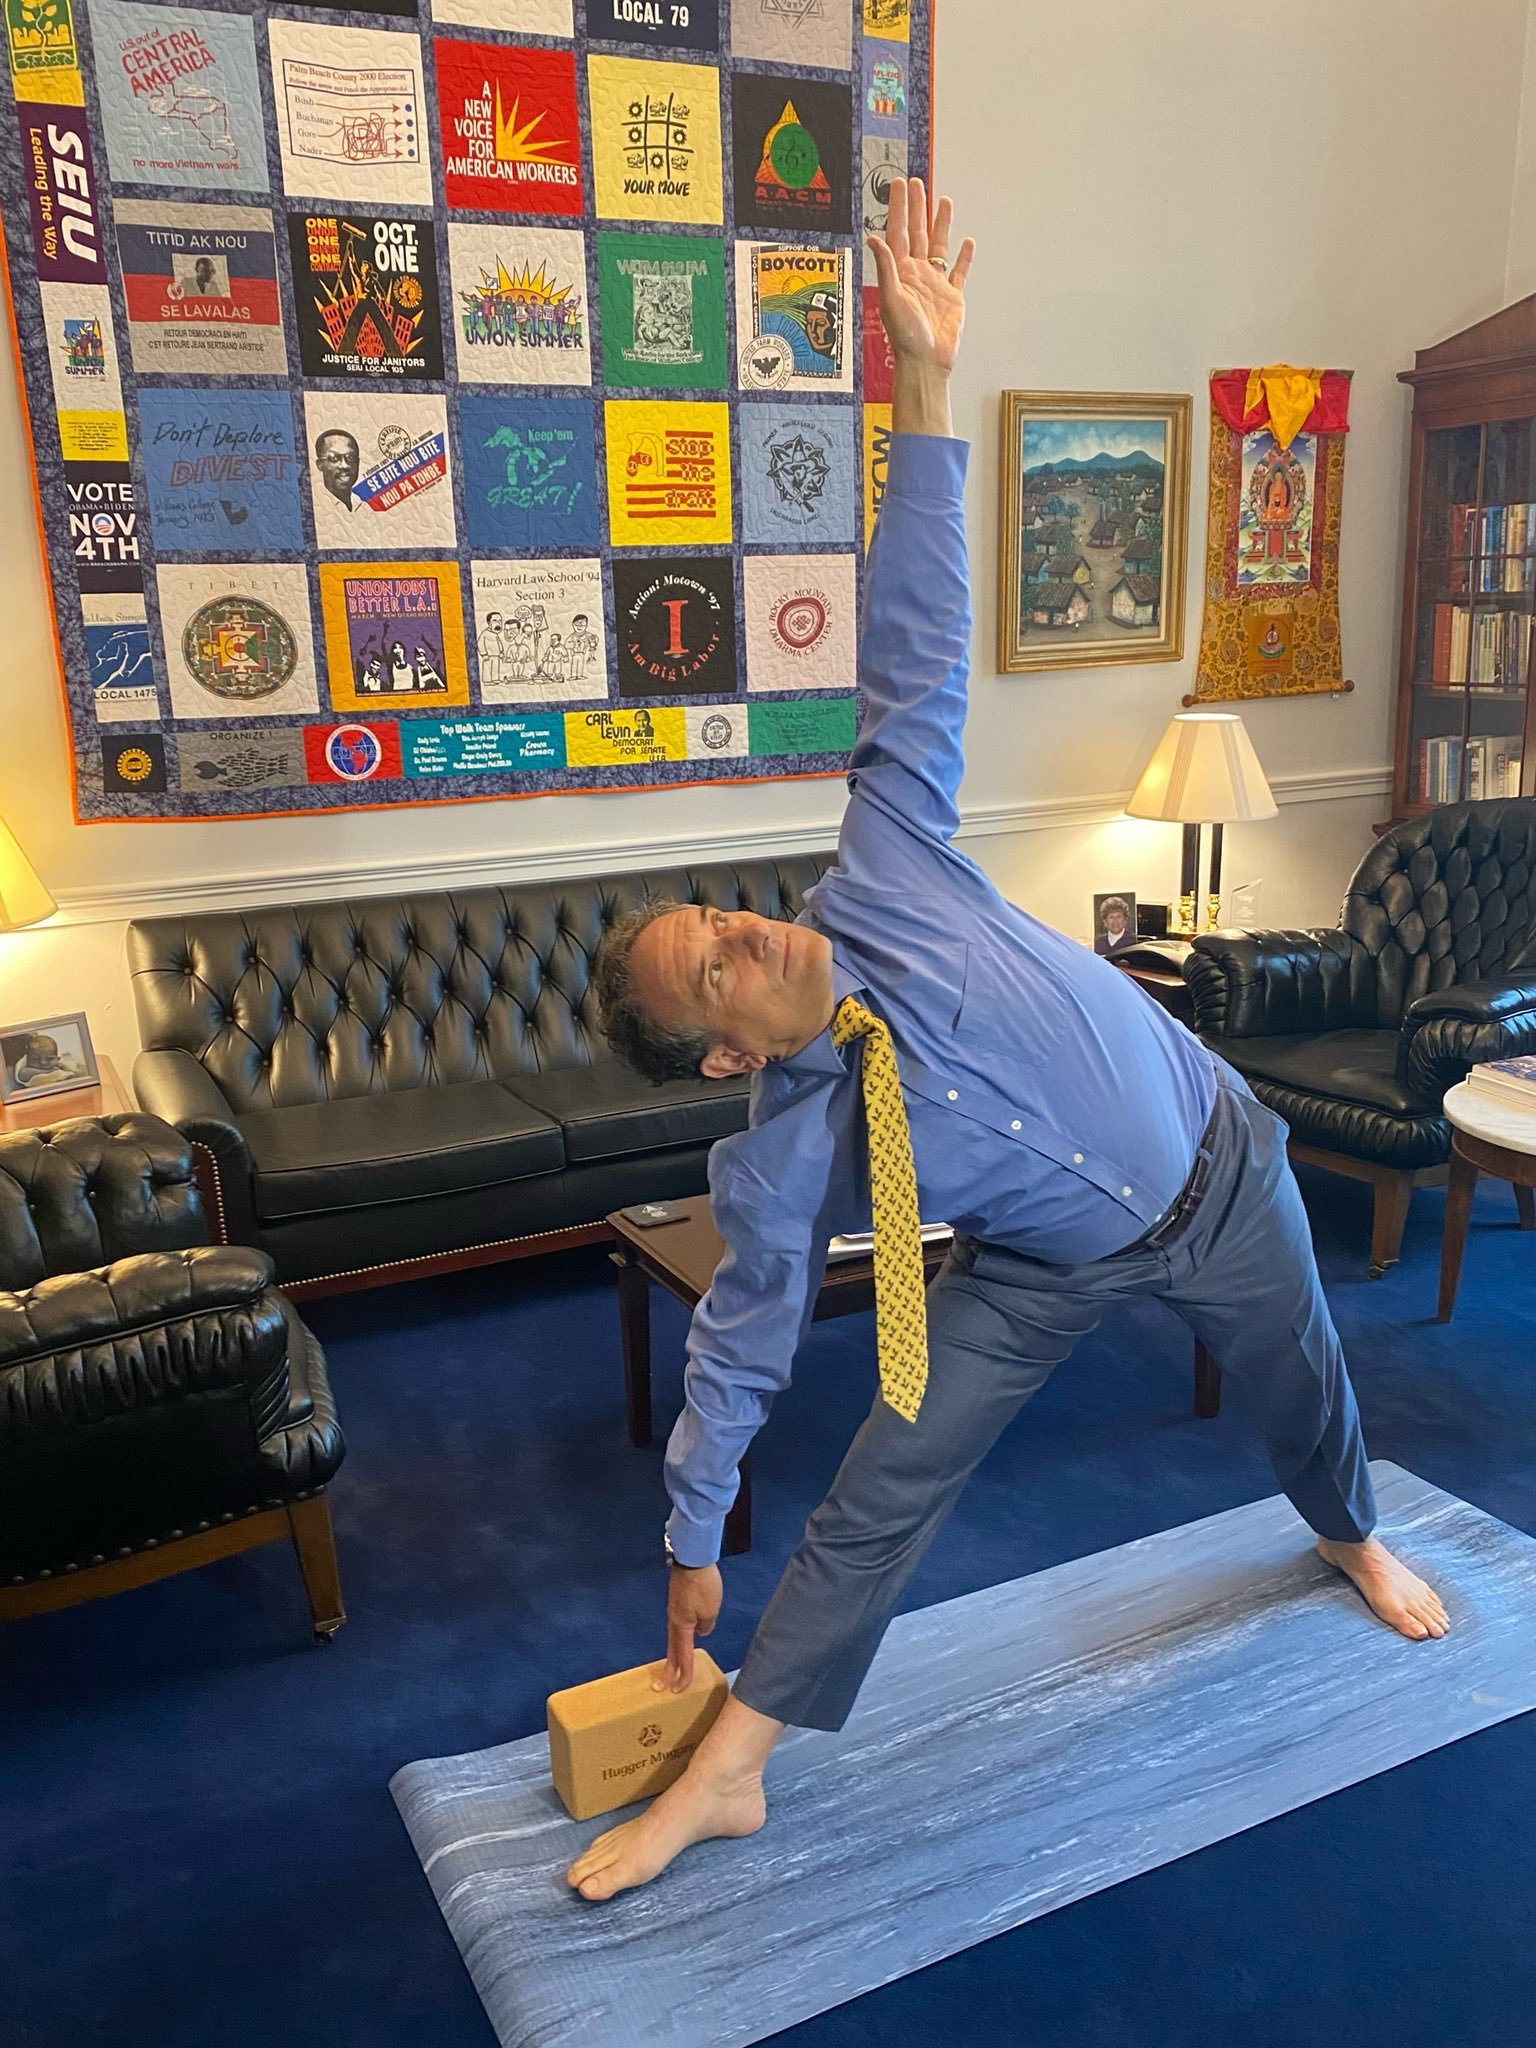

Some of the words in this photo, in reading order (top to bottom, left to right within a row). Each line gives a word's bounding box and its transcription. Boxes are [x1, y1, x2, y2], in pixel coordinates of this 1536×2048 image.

[613, 0, 663, 24] LOCAL
[671, 5, 689, 26] 79
[136, 33, 152, 46] out
[151, 28, 160, 39] of
[121, 28, 206, 74] CENTRAL
[130, 48, 216, 97] AMERICA
[290, 64, 308, 74] Palm
[310, 68, 331, 78] Beach
[333, 72, 357, 82] County
[482, 80, 491, 98] A
[295, 96, 314, 105] Bush
[464, 99, 492, 119] NEW
[296, 112, 333, 125] Buchanan
[298, 128, 317, 138] Gore
[454, 118, 494, 139] VOICE
[300, 145, 323, 155] Nader
[469, 140, 494, 159] FOR
[29, 128, 49, 192] Leading
[133, 159, 146, 167] no
[150, 159, 173, 169] more
[175, 160, 213, 169] Vietnam
[446, 156, 514, 179] AMERICAN
[517, 163, 577, 185] WORKERS
[48, 124, 97, 263] SEIU
[624, 179, 654, 196] YOUR
[658, 181, 690, 196] MOVE
[39, 195, 53, 221] the
[305, 218, 337, 228] ONE
[146, 231, 184, 247] TITID
[190, 235, 211, 248] AK
[215, 236, 247, 249] NOU
[307, 236, 339, 245] ONE
[374, 221, 419, 245] OCT.
[41, 225, 57, 260] Way
[310, 254, 341, 263] ONE
[375, 244, 419, 273] ONE
[761, 257, 836, 272] BOYCOTT
[160, 305, 180, 317] SE
[184, 305, 250, 319] LAVALAS
[164, 329, 187, 338] RETOUR
[466, 330, 516, 348] UNION
[520, 333, 583, 349] SUMMER
[207, 342, 237, 350] BERTRAND
[239, 343, 264, 351] ARISTIDE
[744, 344, 755, 364] UNITED
[757, 338, 770, 347] FARM
[773, 338, 791, 360] WORKERS
[322, 354, 359, 364] JUSTICE
[362, 357, 379, 365] FOR
[382, 357, 425, 366] JANITORS
[347, 364, 363, 372] SEIU
[366, 365, 389, 373] LOCAL
[65, 366, 105, 375] SUMMER
[152, 418, 215, 447] Don't
[213, 422, 285, 450] Deplore
[528, 428, 552, 443] Keep
[554, 429, 573, 441] 'em
[667, 437, 712, 459] stop
[170, 453, 292, 487] DIVEST
[367, 475, 382, 492] SE
[379, 463, 401, 484] BITE
[398, 451, 420, 472] NOU
[418, 440, 440, 460] BITE
[680, 463, 712, 482] the
[66, 483, 133, 502] VOTE
[379, 485, 401, 508] NOU
[399, 479, 415, 496] PA
[664, 489, 713, 508] draft
[68, 503, 99, 511] OBAMA
[69, 513, 136, 536] NOV
[75, 536, 140, 560] 4TH
[188, 581, 279, 590] TIBET
[346, 580, 393, 596] UNION
[396, 580, 427, 597] JOBS
[477, 575, 521, 588] Harvard
[524, 574, 545, 584] Law
[547, 572, 584, 583] School
[585, 572, 600, 582] '94
[515, 591, 555, 601] Section
[558, 588, 565, 598] 3
[629, 579, 660, 620] Action!
[663, 574, 706, 595] Motown
[349, 597, 400, 612] BETTER
[769, 593, 789, 622] ROCKY
[794, 588, 833, 615] MOUNTAIN
[662, 599, 689, 655] I
[770, 628, 802, 657] DHARMA
[804, 621, 833, 655] CENTER
[628, 644, 646, 666] Am
[649, 663, 676, 681] Big
[681, 634, 719, 677] Labor
[95, 691, 132, 699] LOCAL
[134, 689, 156, 698] 1475
[585, 713, 613, 726] CARL
[209, 731, 265, 740] ORGANIZE
[440, 724, 454, 736] Top
[455, 724, 474, 733] Walk
[475, 723, 494, 732] Team
[601, 724, 630, 739] LEVIN
[613, 739, 654, 747] DEMOCRAT
[641, 746, 666, 754] SENATE
[519, 748, 555, 757] Pharmacy
[602, 1759, 647, 1781] Hugger
